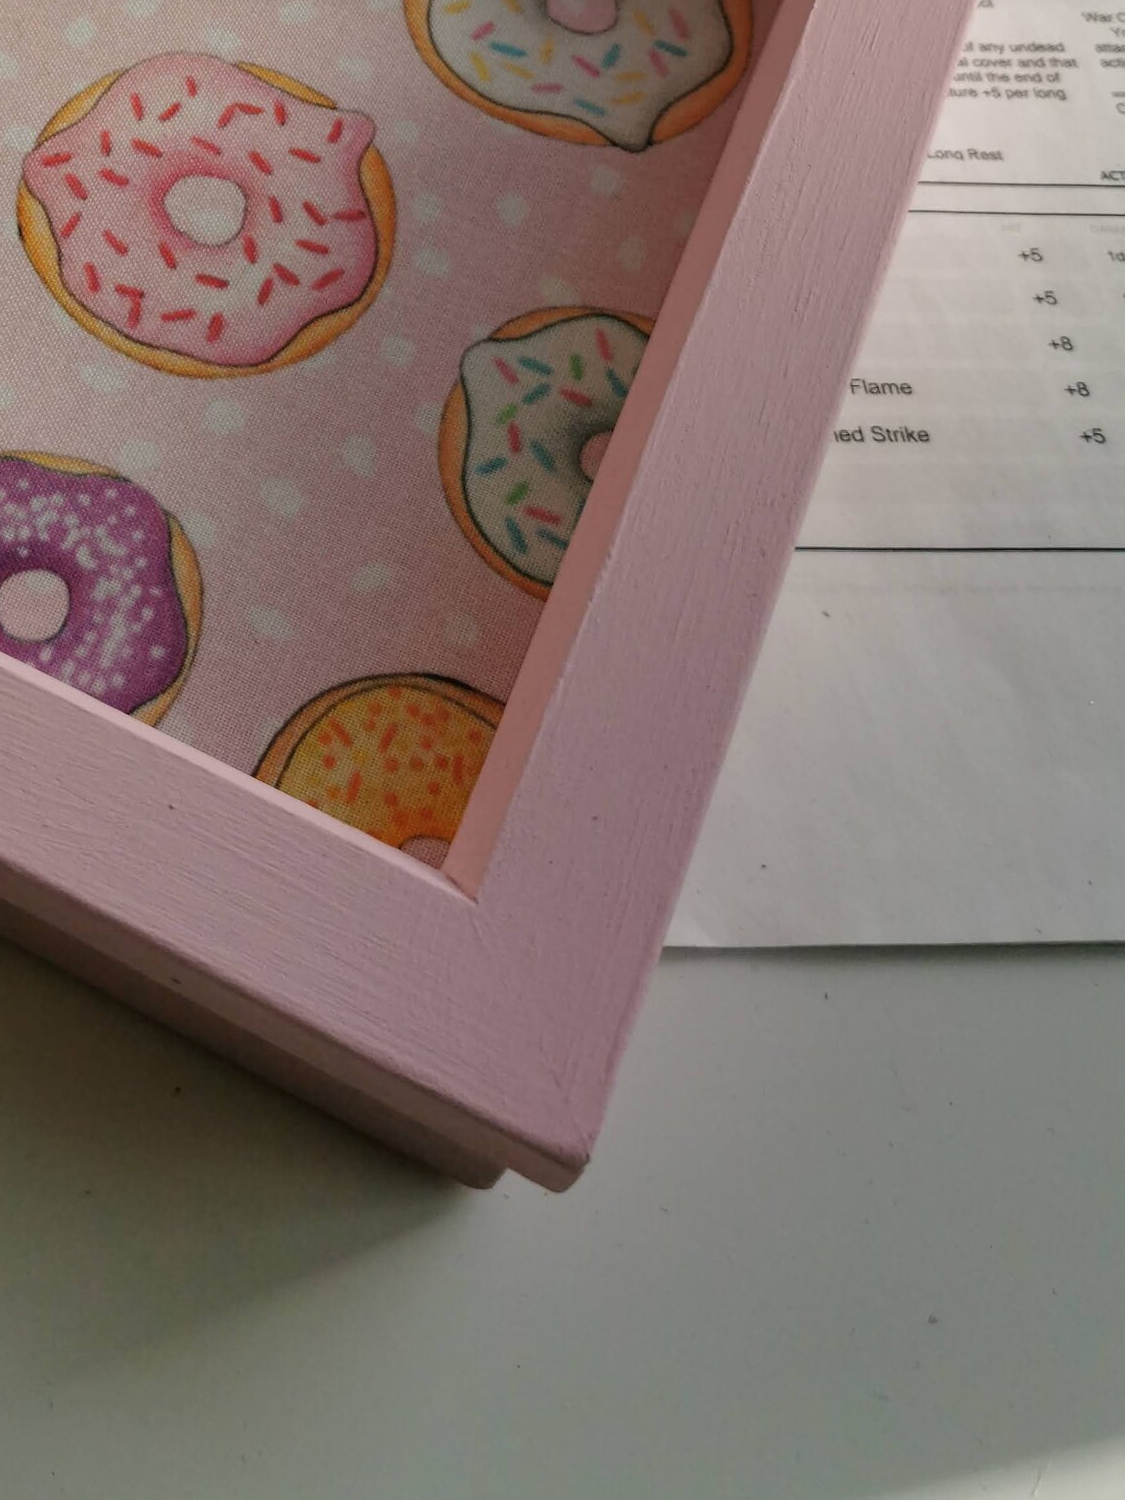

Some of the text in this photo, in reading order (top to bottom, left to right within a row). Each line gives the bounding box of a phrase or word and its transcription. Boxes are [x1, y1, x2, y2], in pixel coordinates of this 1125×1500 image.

[978, 42, 1005, 55] any
[1009, 41, 1066, 52] undead
[972, 58, 1012, 68] cover
[1017, 57, 1046, 68] and
[1049, 57, 1079, 68] that
[986, 72, 1010, 82] the
[1014, 72, 1043, 82] end
[1032, 87, 1068, 102] long
[967, 149, 1005, 161] Rest
[1018, 247, 1044, 262] +5
[1032, 290, 1058, 306] +5
[1048, 336, 1074, 351] +8
[850, 379, 913, 395] Flame
[1064, 381, 1091, 397] +8
[871, 426, 931, 443] Strike
[1079, 428, 1107, 444] +5
